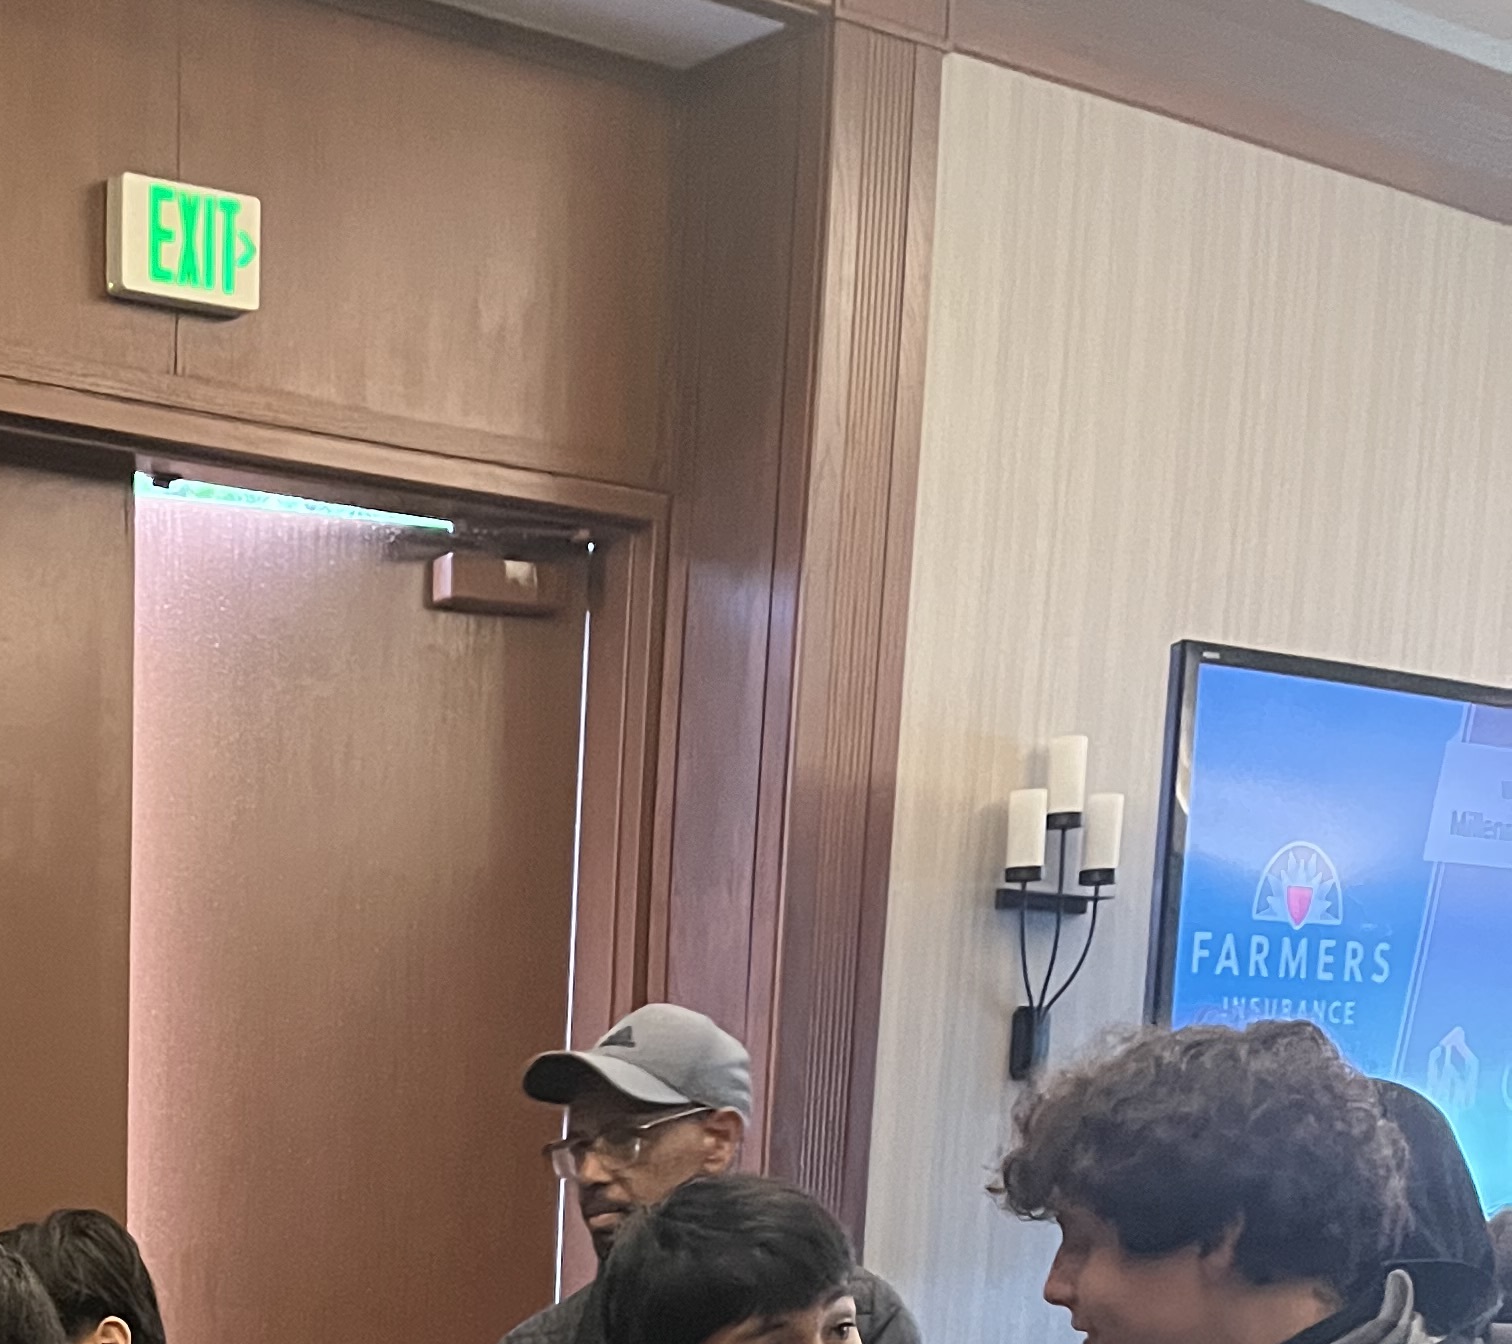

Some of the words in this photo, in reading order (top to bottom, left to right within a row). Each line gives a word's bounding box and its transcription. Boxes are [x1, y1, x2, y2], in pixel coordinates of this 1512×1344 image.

[149, 183, 241, 295] EXIT
[1191, 930, 1392, 984] FARMERS
[1222, 996, 1356, 1026] INSURANCE
